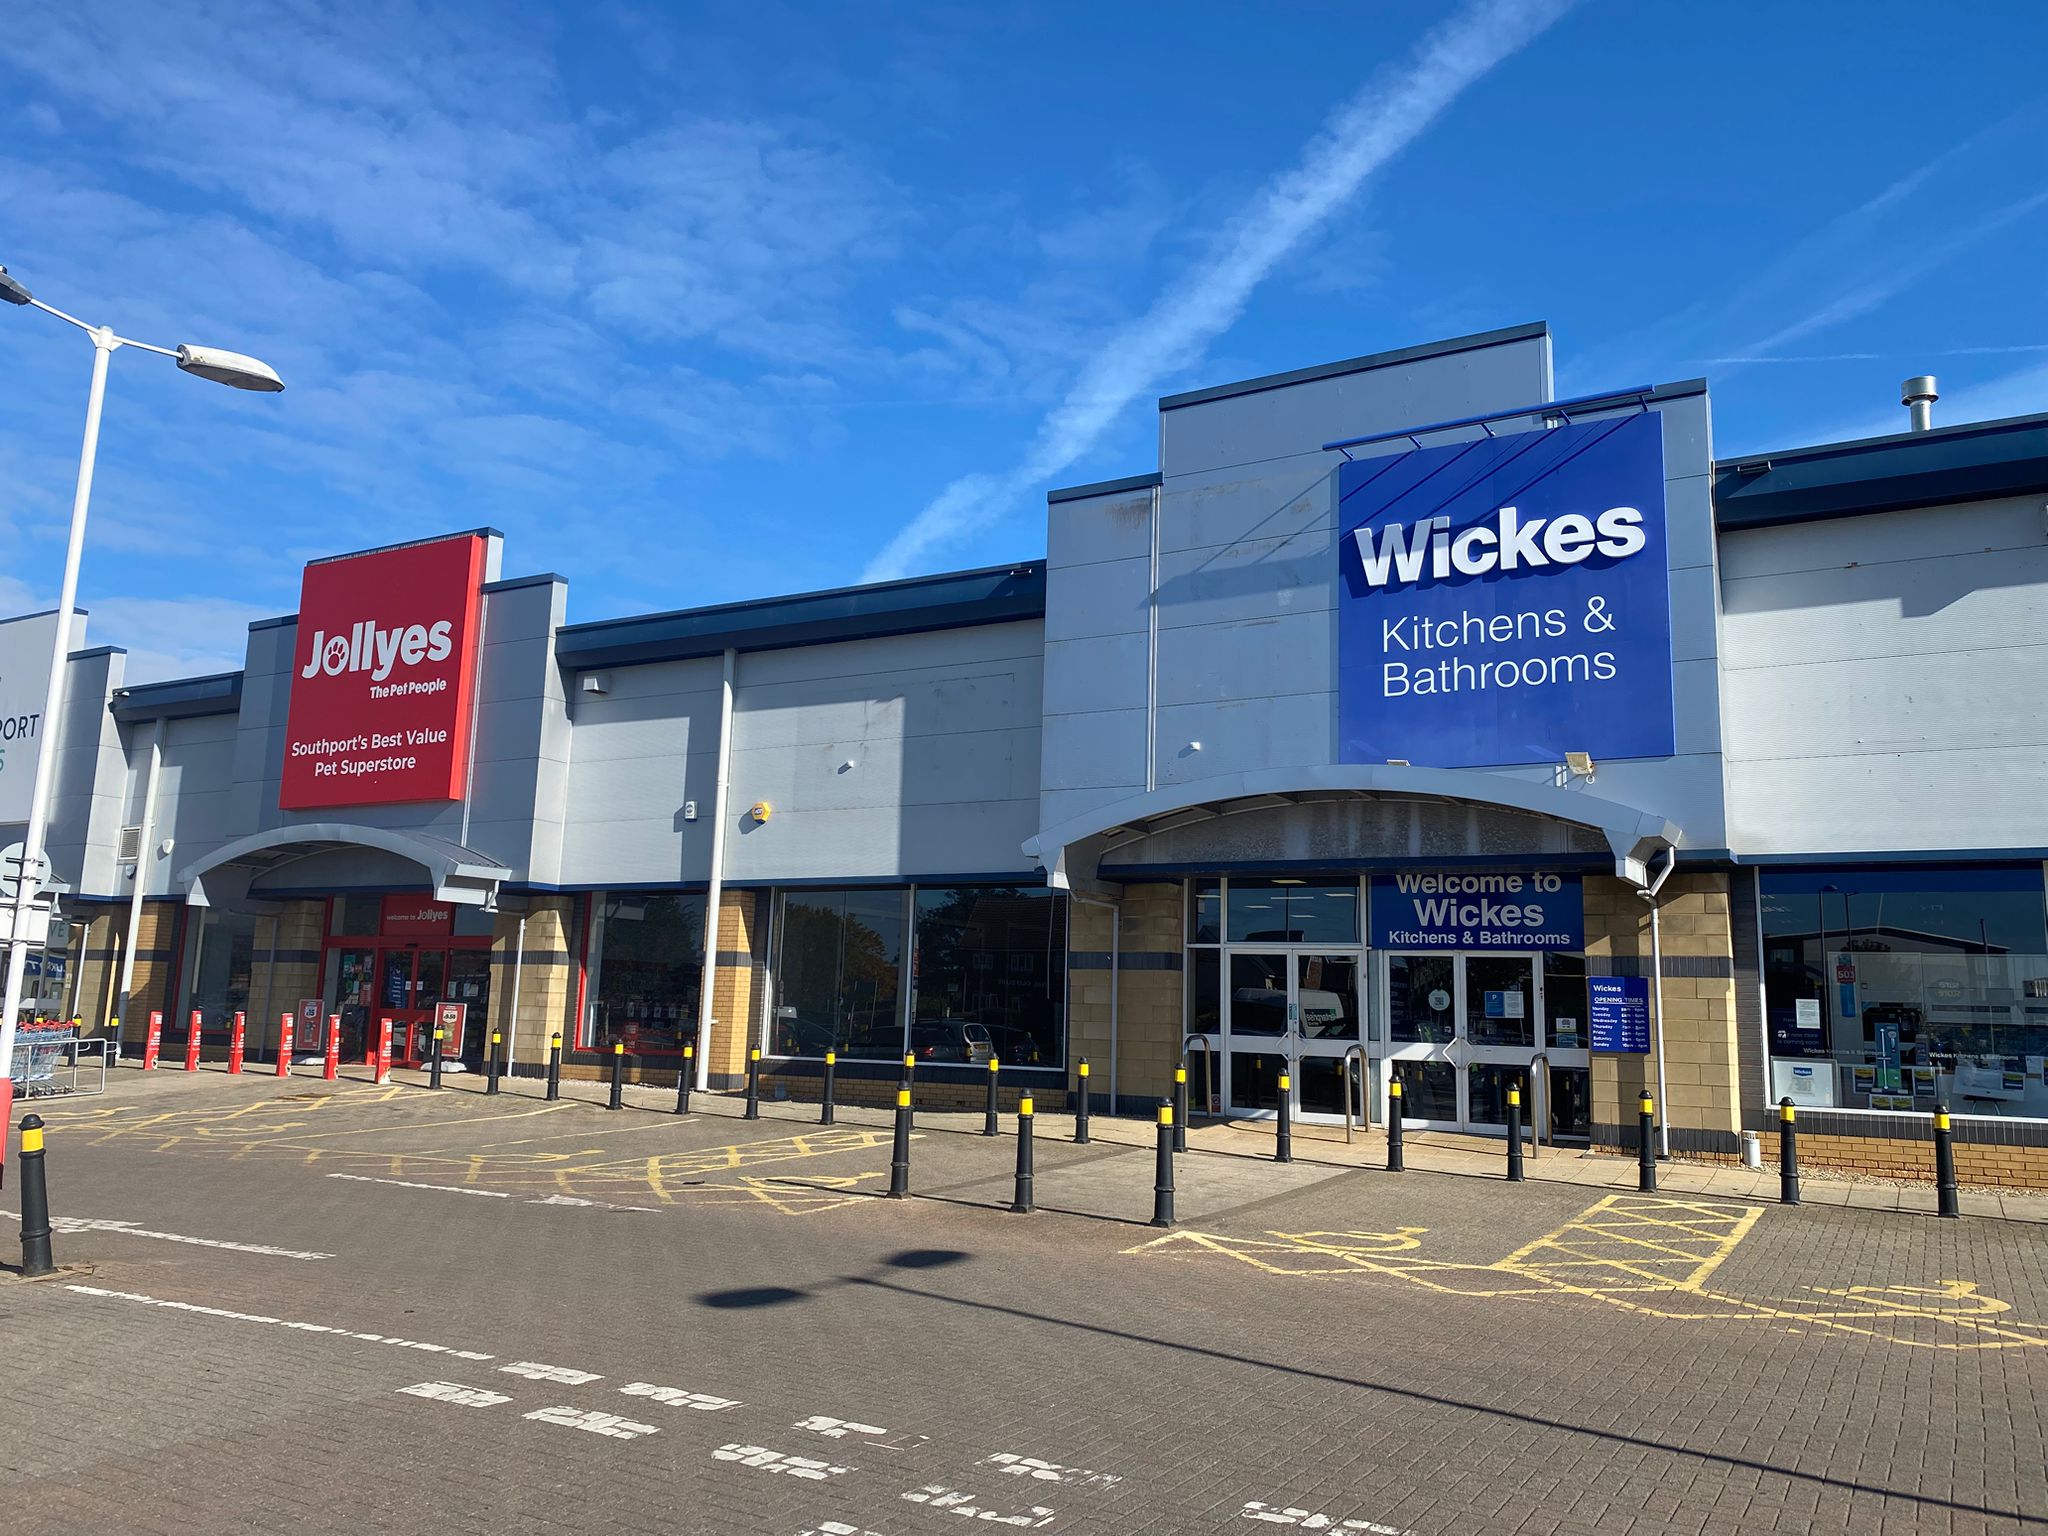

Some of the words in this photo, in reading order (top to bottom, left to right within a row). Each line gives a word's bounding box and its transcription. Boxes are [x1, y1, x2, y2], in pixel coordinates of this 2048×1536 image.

[1353, 506, 1646, 586] Wickes
[1383, 607, 1567, 653] Kitchens
[1583, 596, 1616, 633] &
[301, 620, 453, 682] Jollyes
[370, 686, 389, 699] The
[390, 683, 408, 697] Pet
[408, 678, 447, 695] People
[1383, 651, 1617, 697] Bathrooms
[291, 735, 368, 757] Southport's
[371, 732, 402, 749] Best
[406, 728, 447, 745] Value
[315, 761, 337, 777] Pet
[340, 756, 416, 777] Superstore
[1395, 873, 1523, 894] Welcome
[1532, 872, 1562, 893] to
[417, 909, 448, 922] Jollyes
[1413, 898, 1545, 927] Wickes
[1389, 931, 1457, 944] Kitchens
[1462, 931, 1474, 944] &
[1480, 931, 1570, 945] Bathrooms
